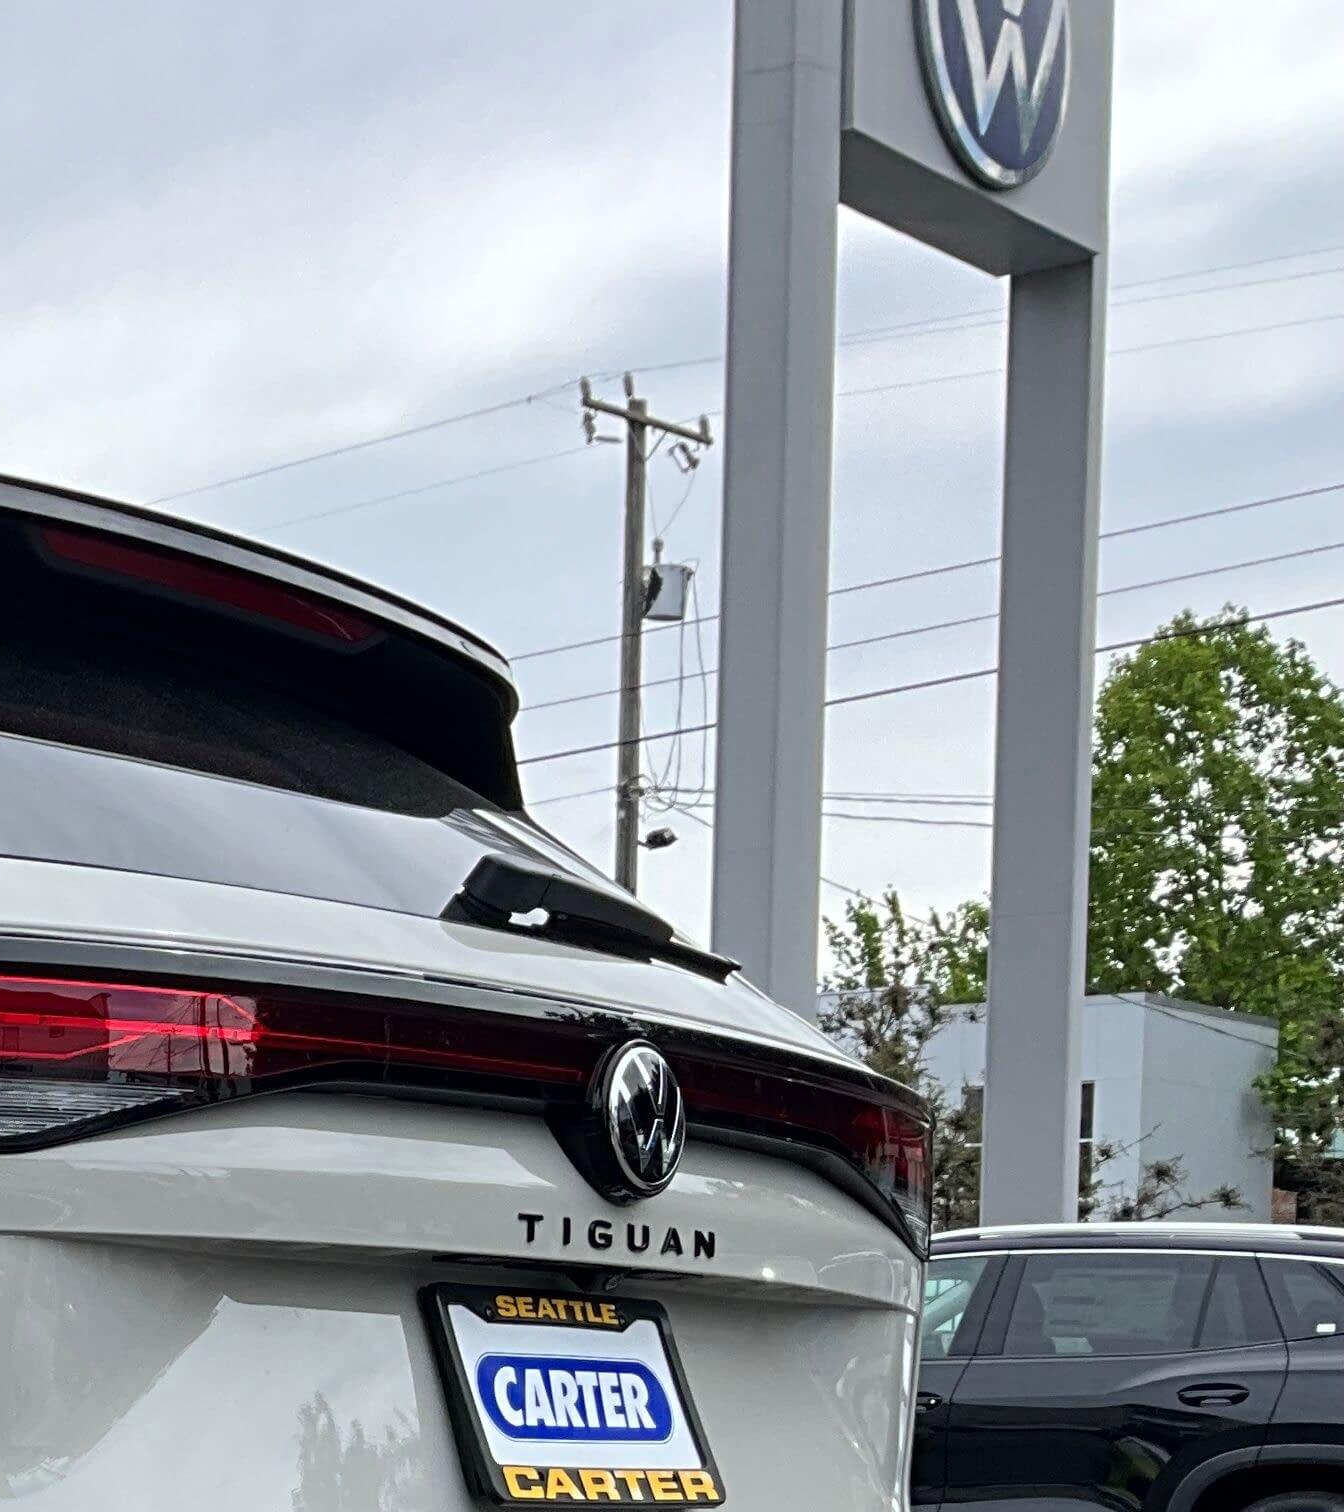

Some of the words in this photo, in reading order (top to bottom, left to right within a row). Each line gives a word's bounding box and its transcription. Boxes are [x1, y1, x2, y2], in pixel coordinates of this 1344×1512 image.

[518, 1212, 716, 1259] TIGUAN
[494, 1294, 620, 1327] SEATTLE
[493, 1365, 657, 1430] CARTER
[502, 1465, 720, 1502] CARTER
